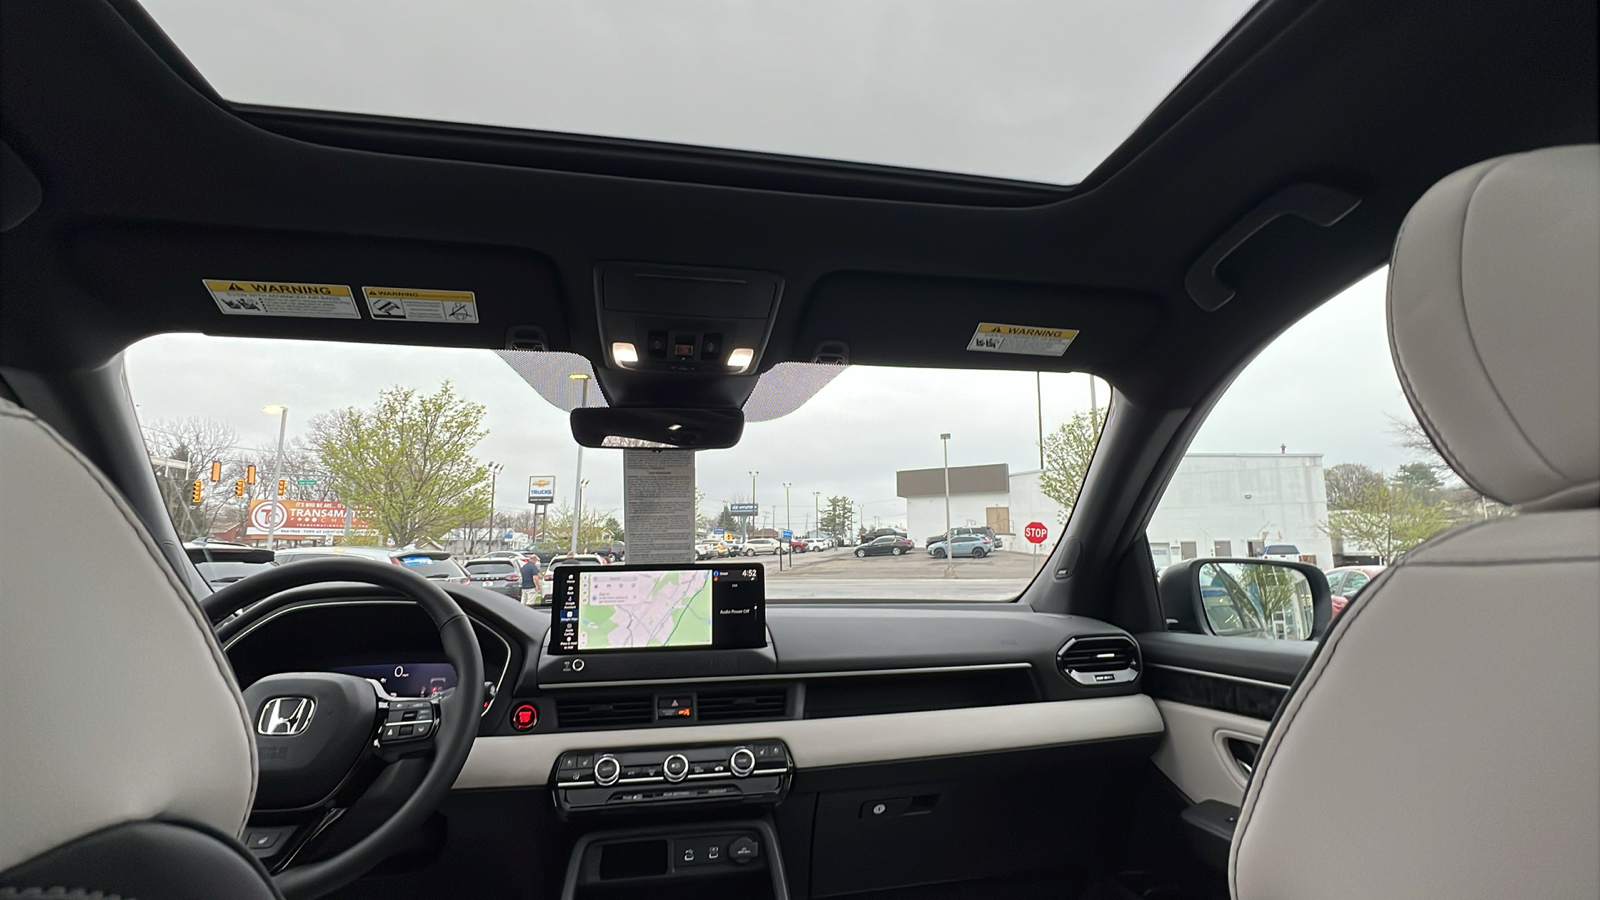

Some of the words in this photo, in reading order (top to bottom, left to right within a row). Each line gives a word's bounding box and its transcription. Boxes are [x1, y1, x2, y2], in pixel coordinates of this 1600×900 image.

[251, 283, 331, 294] WARNING
[1008, 327, 1062, 337] WARNING
[1025, 527, 1047, 538] STOP
[742, 569, 757, 577] 4:52
[394, 665, 404, 678] 0
